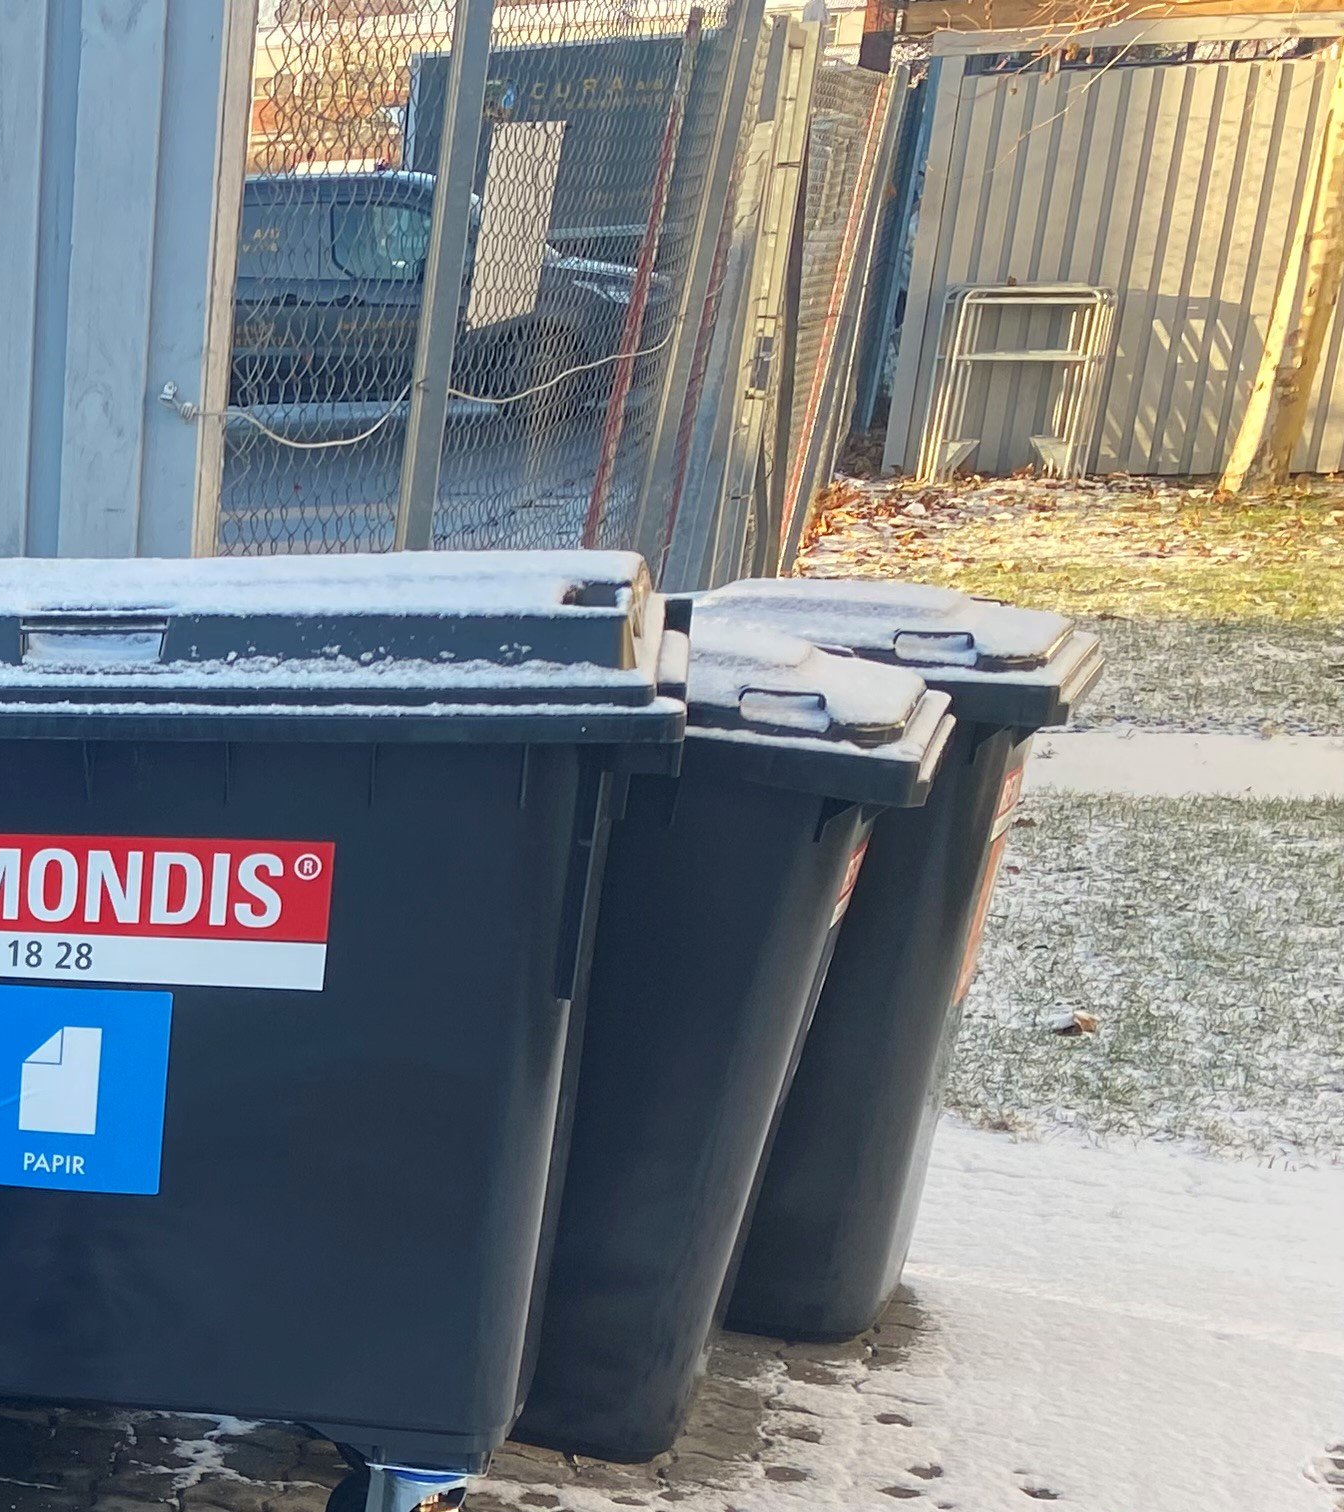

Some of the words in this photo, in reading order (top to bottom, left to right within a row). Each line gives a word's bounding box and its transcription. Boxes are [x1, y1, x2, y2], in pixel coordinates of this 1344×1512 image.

[7, 939, 43, 969] 18
[54, 941, 94, 971] 28
[23, 1151, 85, 1176] PAPIR
